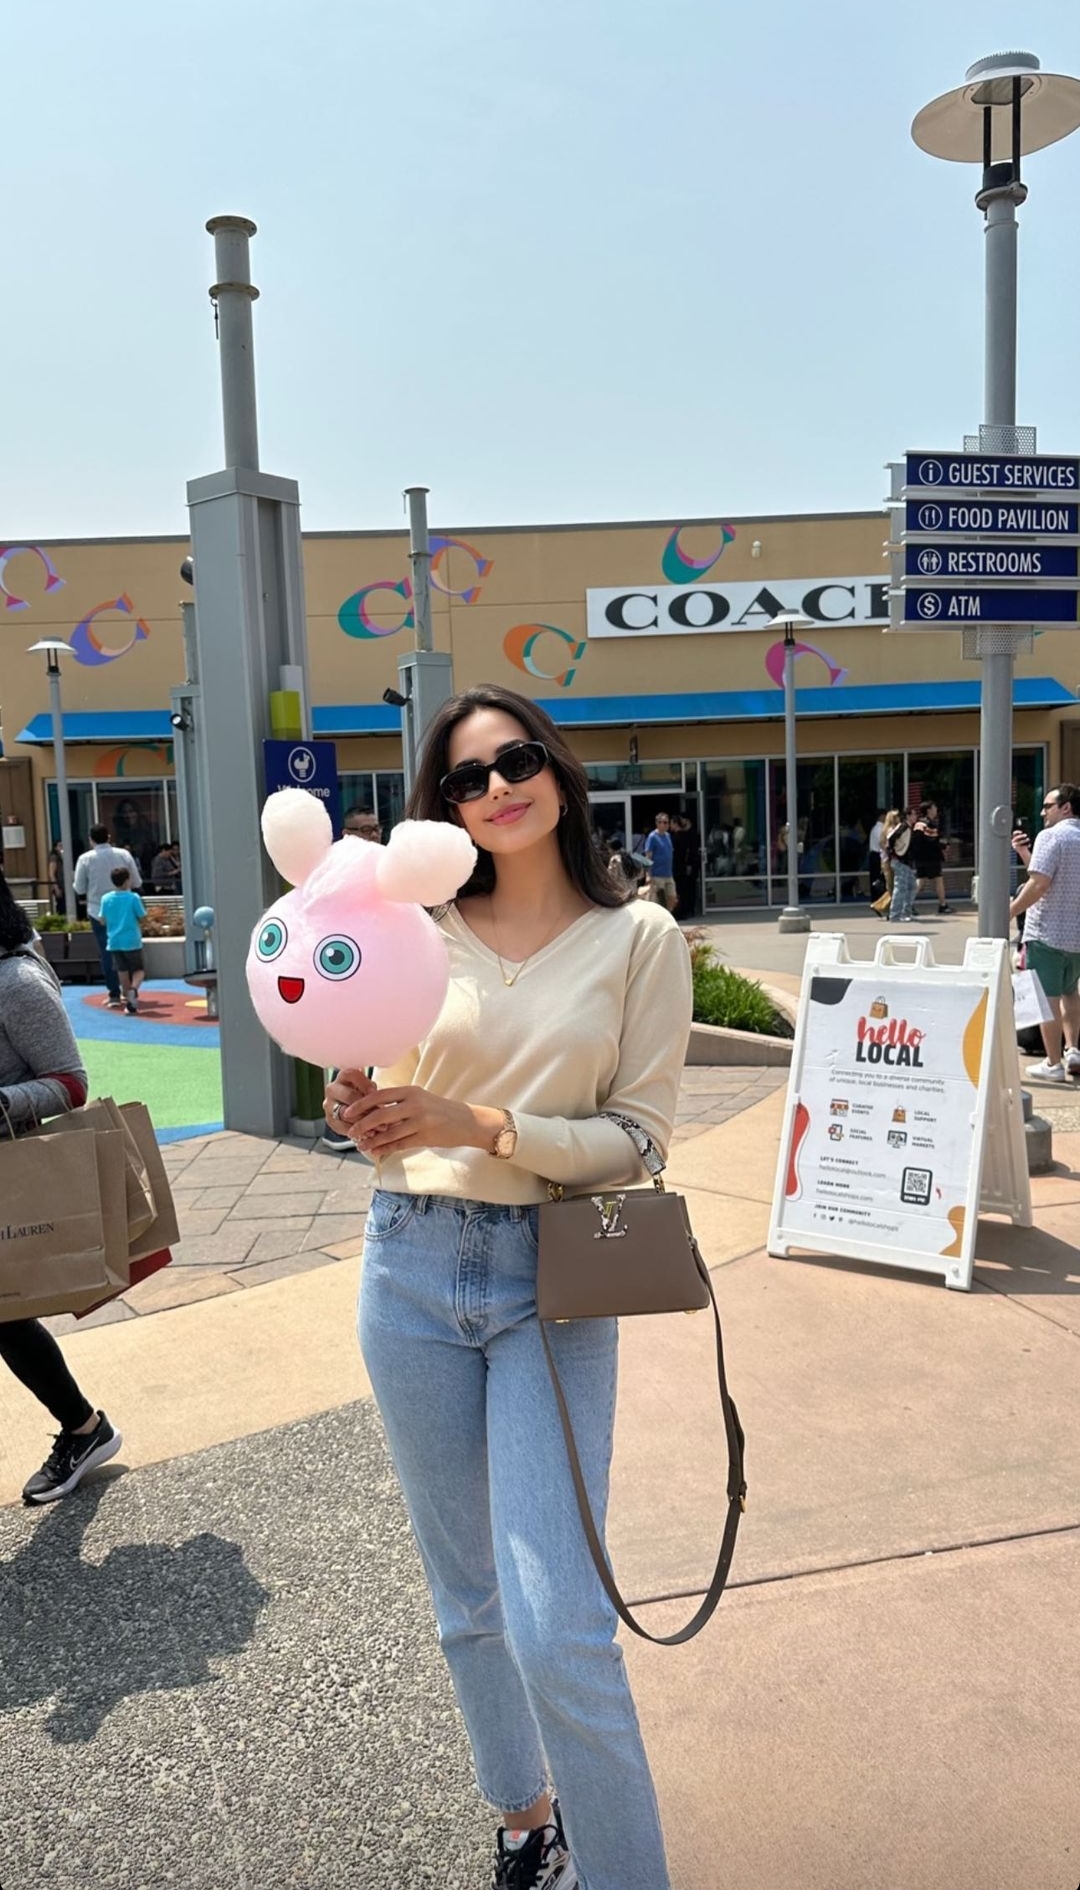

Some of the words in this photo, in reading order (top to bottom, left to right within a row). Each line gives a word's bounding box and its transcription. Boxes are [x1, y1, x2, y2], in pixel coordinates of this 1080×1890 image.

[949, 463, 1000, 484] GUEST
[1004, 464, 1075, 487] SERVICES
[949, 507, 993, 528] FOOD
[998, 509, 1069, 530] PAVILION
[948, 552, 1041, 573] RESTROOMS
[948, 596, 981, 616] ATM
[857, 1016, 927, 1048] hello
[855, 1041, 924, 1068] LOCAL
[7, 1222, 55, 1240] LAUREN
